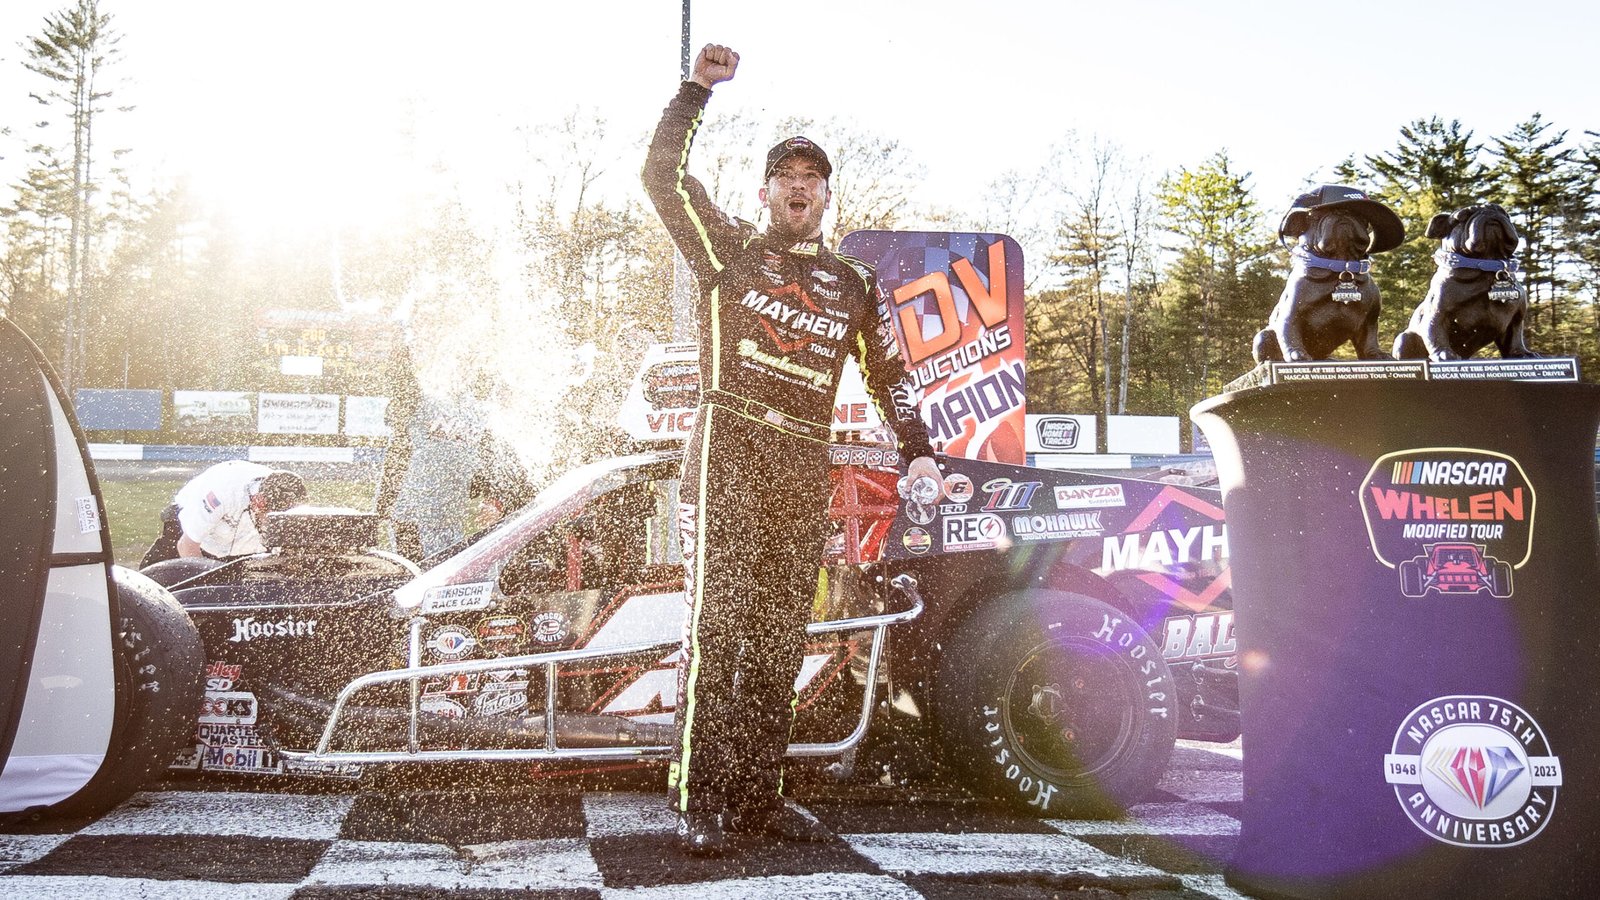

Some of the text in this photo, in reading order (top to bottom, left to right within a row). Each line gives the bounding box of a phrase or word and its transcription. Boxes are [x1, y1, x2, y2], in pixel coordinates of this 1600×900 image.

[892, 240, 1008, 365] DV
[741, 290, 849, 340] MAYHEW
[810, 342, 836, 358] TOOLS
[646, 412, 697, 433] VIC
[1420, 462, 1507, 485] NASCAR
[1058, 486, 1120, 500] BANZAI
[1370, 487, 1524, 520] WHELEN
[84, 499, 95, 530] ZODIAC
[1014, 512, 1100, 533] MOHAWK
[1403, 524, 1503, 539] MODIFIED TOUR
[1101, 524, 1229, 572] MAYH
[445, 585, 483, 597] NASCAR
[432, 598, 481, 609] RACE CAR
[230, 617, 317, 643] Hoosier
[1092, 614, 1168, 718] Hoosier
[200, 724, 260, 739] QUARTER
[1407, 702, 1536, 746] NASCAR 75TH
[210, 735, 262, 746] MASTER
[208, 746, 257, 767] Mobil
[982, 704, 1058, 810] Hoosier
[1390, 763, 1416, 776] 1948
[1534, 765, 1557, 777] 2023
[1408, 791, 1547, 841] ANNIVERSARY
